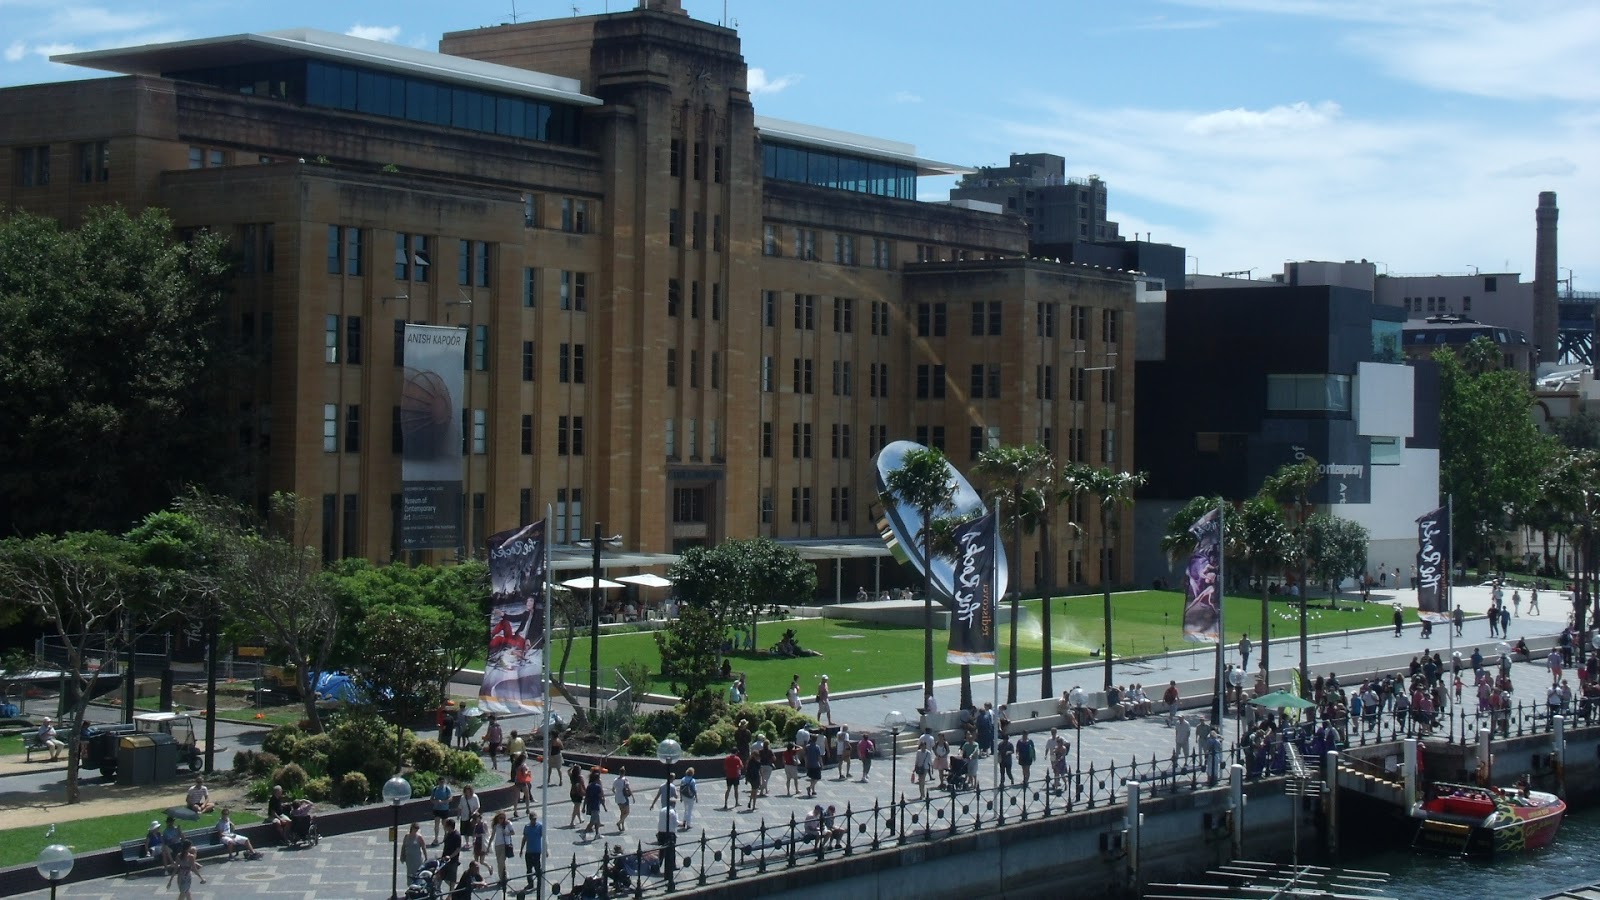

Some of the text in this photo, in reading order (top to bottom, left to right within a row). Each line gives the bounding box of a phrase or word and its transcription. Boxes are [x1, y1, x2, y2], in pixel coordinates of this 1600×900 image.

[407, 333, 461, 346] ANISH KAPOOR
[1292, 445, 1306, 460] of
[1339, 482, 1348, 504] Art
[404, 505, 437, 514] Contemporary
[182, 620, 204, 647] The
